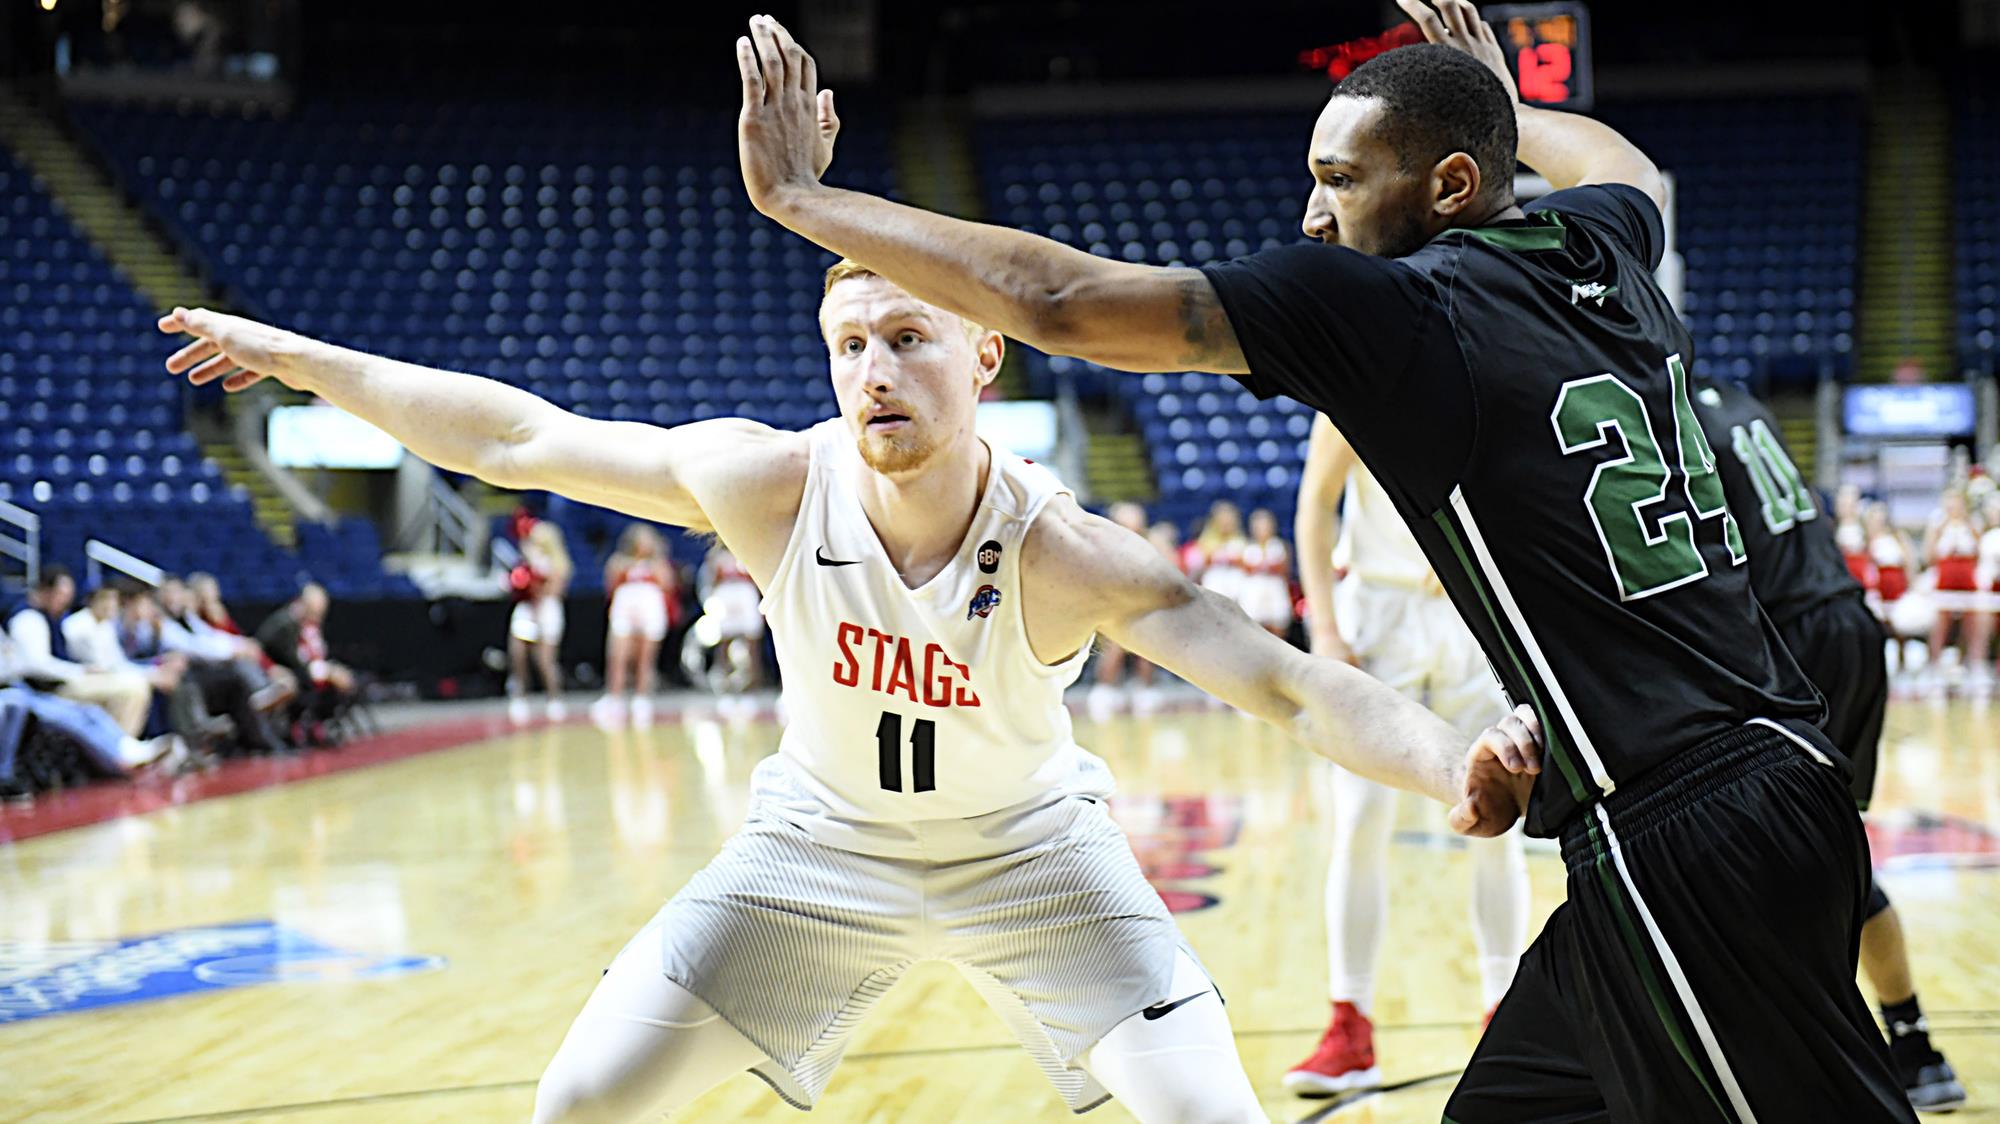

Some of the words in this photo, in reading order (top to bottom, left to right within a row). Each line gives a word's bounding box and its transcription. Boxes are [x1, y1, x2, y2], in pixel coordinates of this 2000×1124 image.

[1551, 354, 1747, 602] 24
[1731, 419, 1817, 535] 11
[876, 711, 936, 793] 11
